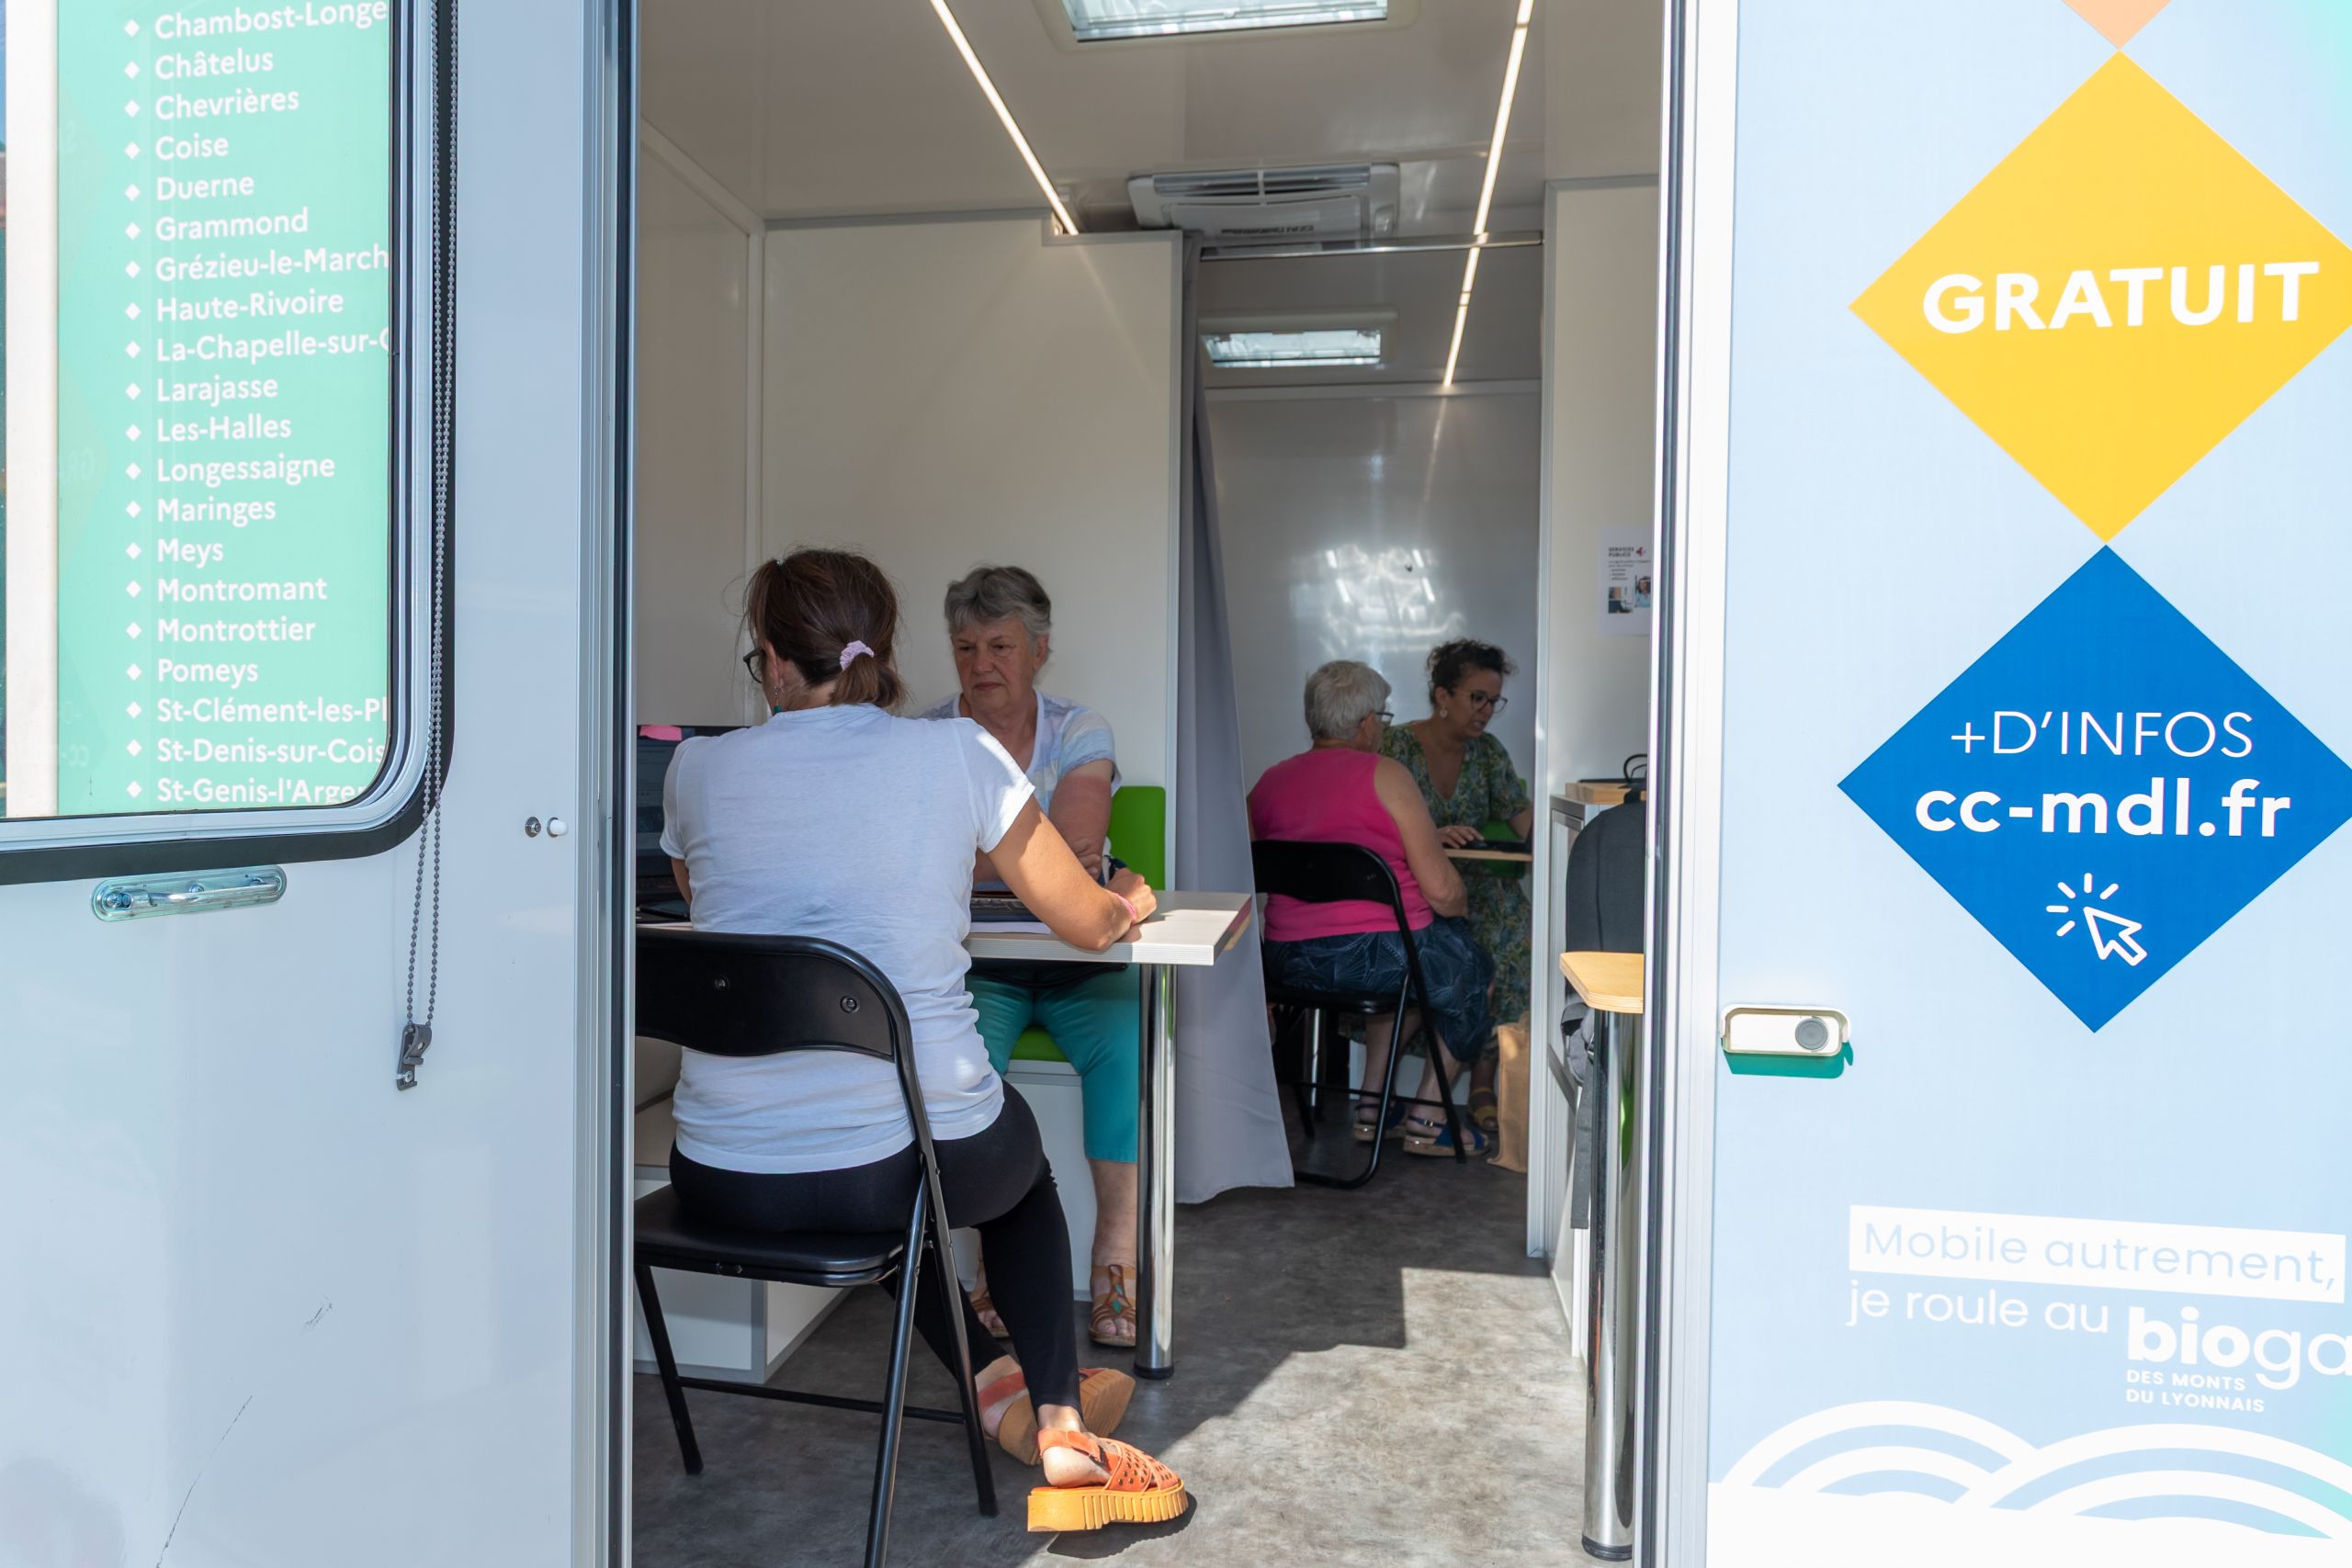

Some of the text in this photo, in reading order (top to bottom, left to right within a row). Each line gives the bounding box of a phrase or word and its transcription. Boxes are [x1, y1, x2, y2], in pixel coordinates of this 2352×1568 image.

[153, 0, 388, 39] Chambost-Longe
[154, 47, 274, 80] Châtelus
[154, 87, 300, 120] Chevrières
[154, 131, 229, 161] Coise
[156, 175, 254, 201] Duerne
[154, 206, 309, 242] Grammond
[155, 243, 390, 282] Grézieu-le-March
[156, 288, 345, 322] Haute-Rivoire
[1922, 261, 2320, 334] GRATUIT
[157, 374, 278, 408] Larajasse
[157, 412, 292, 442] Les-Halles
[157, 452, 335, 489] Longessaigne
[157, 495, 277, 528] Maringes
[157, 537, 224, 570] Meys
[157, 578, 328, 603] Montromant
[157, 615, 316, 643] Montrottier
[158, 658, 259, 690] Pomeys
[157, 695, 388, 723] St-Clément-les-Pl
[157, 737, 386, 764] St-Denis-sur-Cois
[1915, 776, 2292, 838] cc-mdl.fr
[1864, 1222, 2336, 1292] Mobile autrement,
[1845, 1279, 2352, 1391] je roule au bioga
[2126, 1369, 2246, 1392] DES MONTS
[2126, 1388, 2265, 1413] DU LYONNAIS
